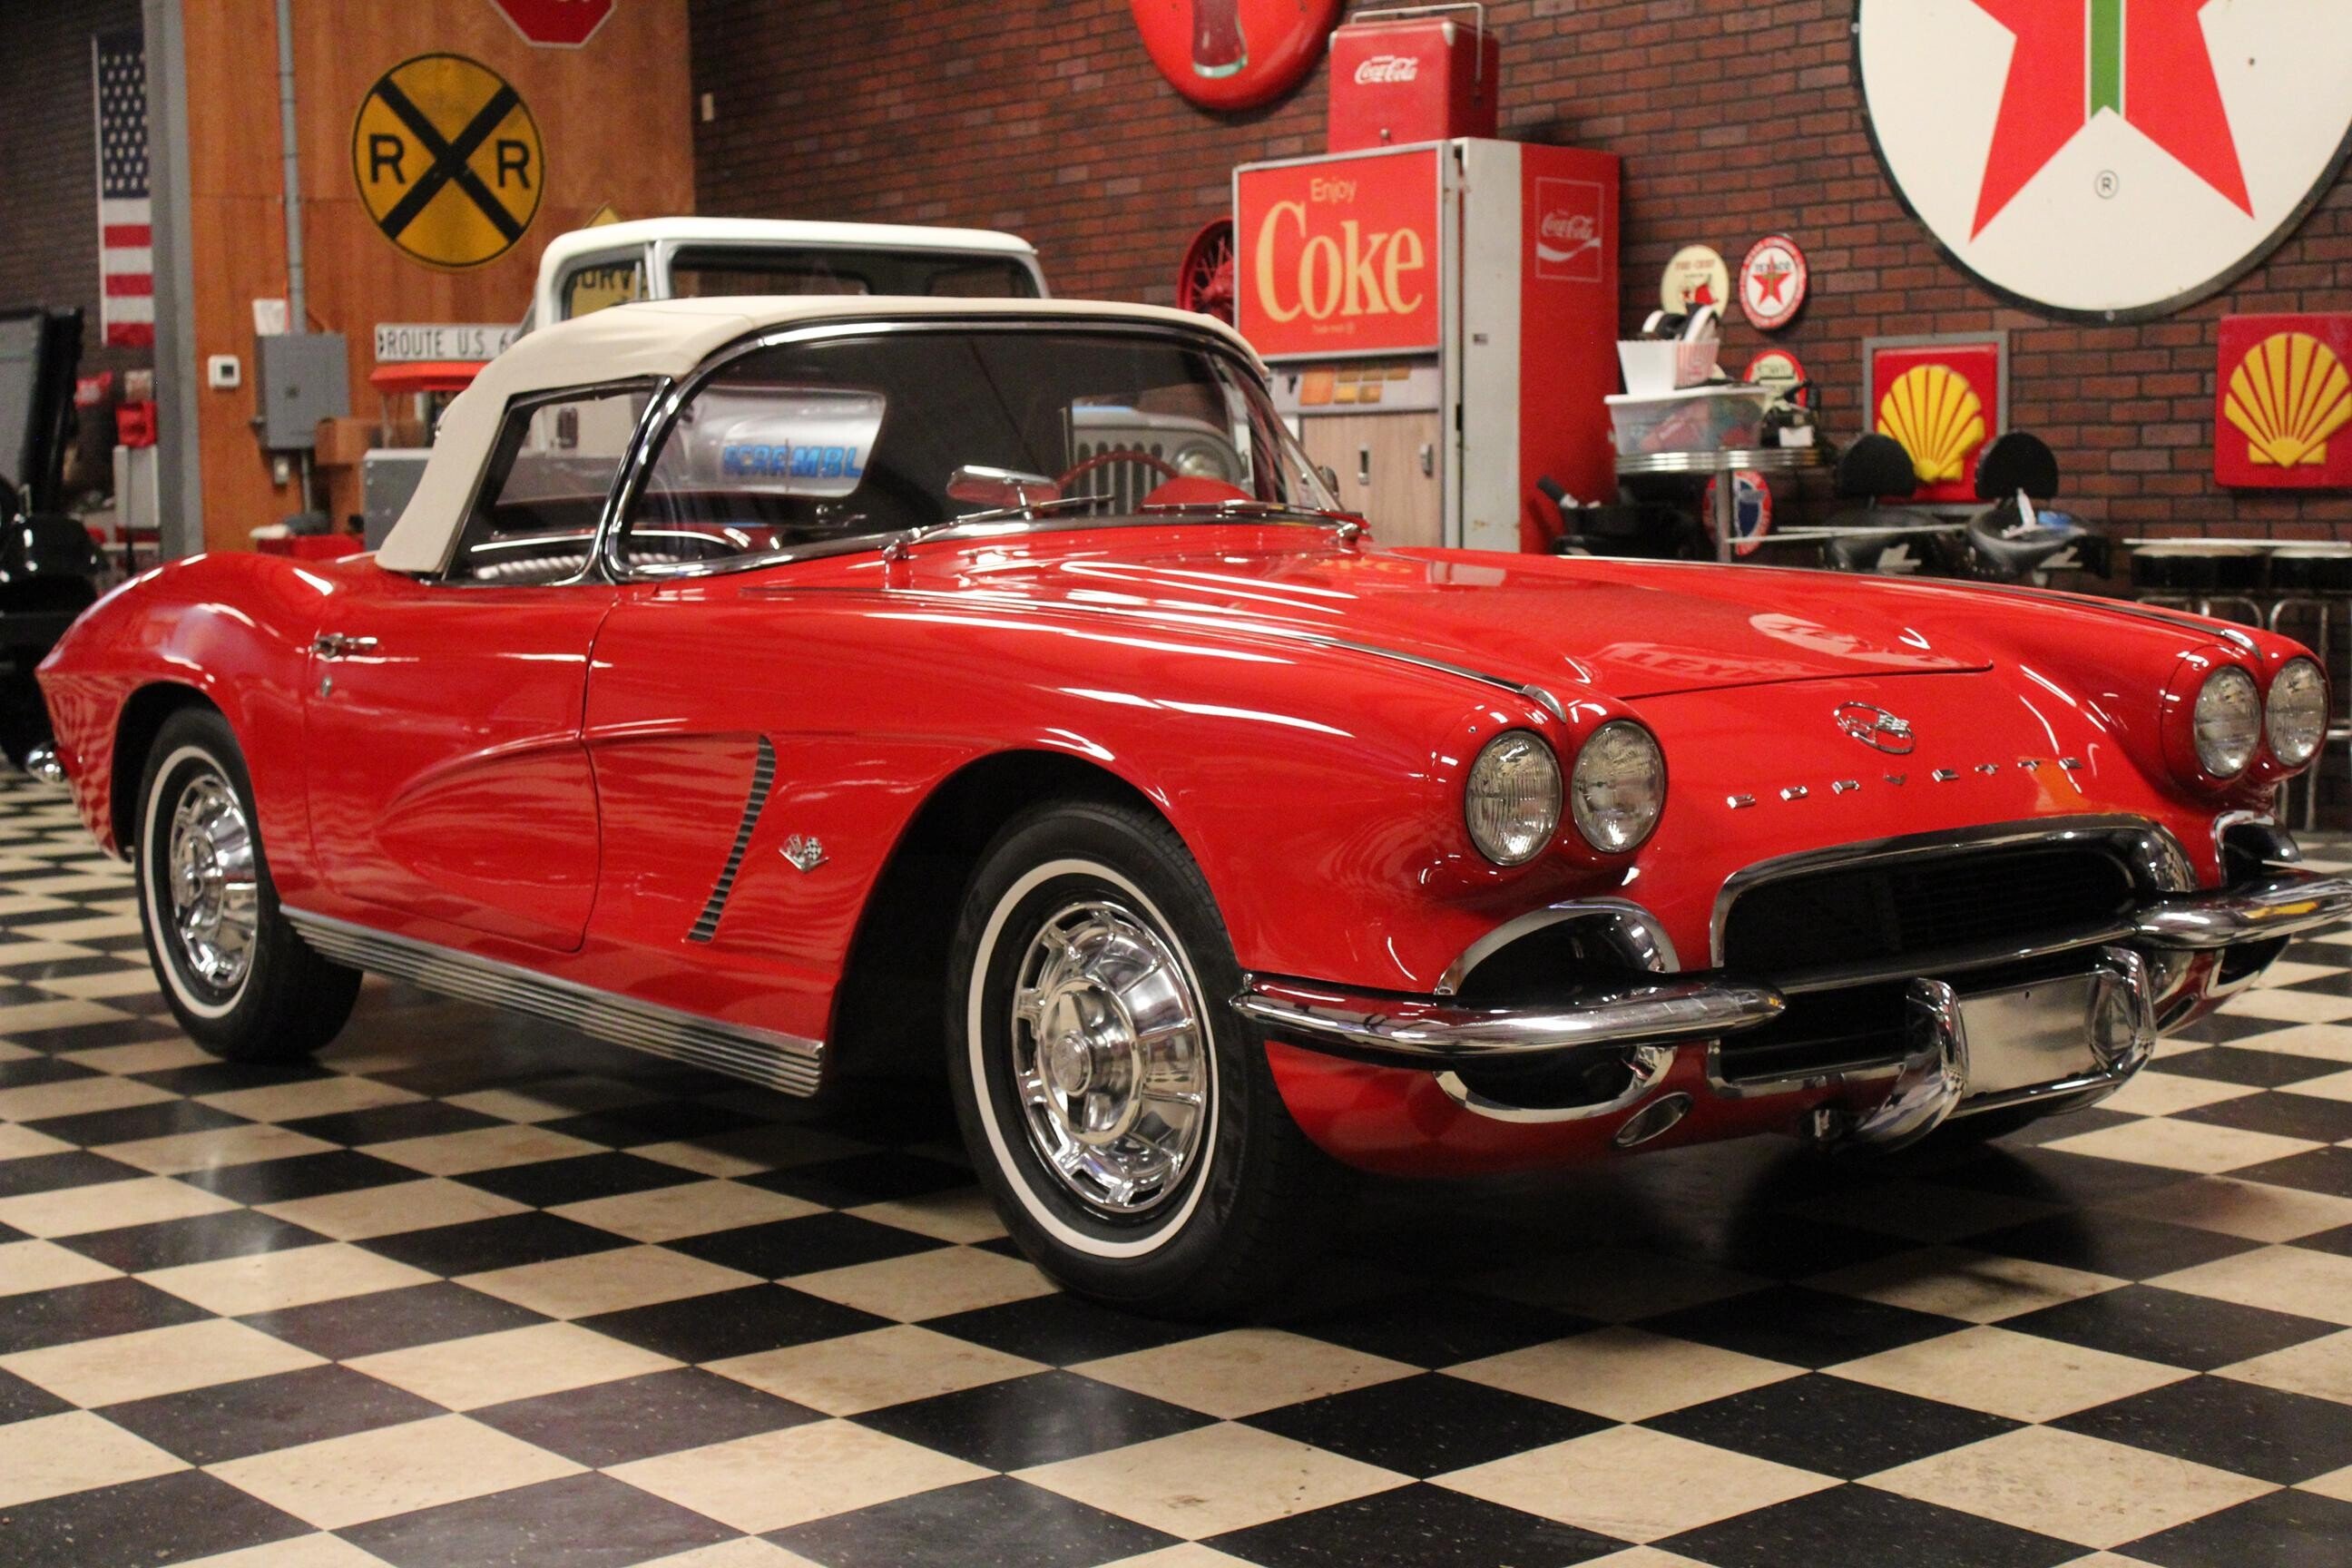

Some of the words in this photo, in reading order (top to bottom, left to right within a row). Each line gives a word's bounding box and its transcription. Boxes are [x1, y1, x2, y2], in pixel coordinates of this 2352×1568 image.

[369, 133, 406, 184] R
[496, 140, 531, 189] R
[1310, 178, 1357, 203] Enjoy
[1256, 201, 1425, 322] Coke
[387, 328, 444, 356] ROUTE
